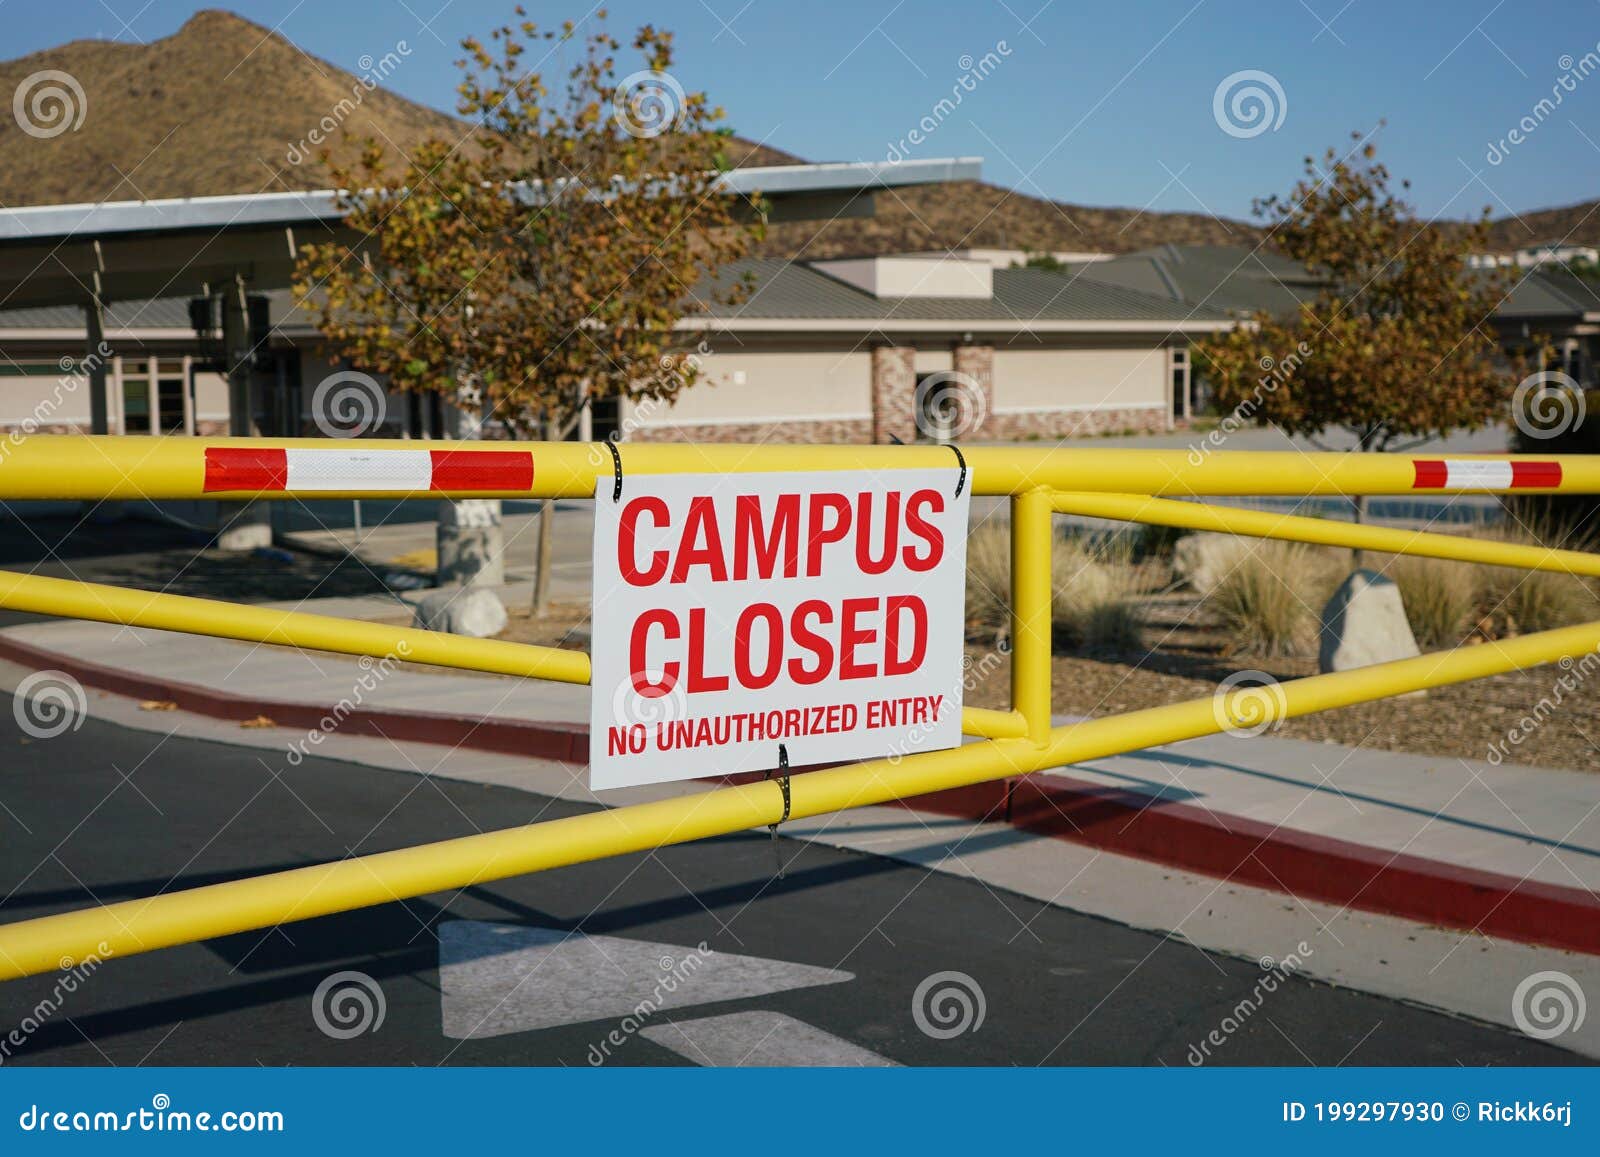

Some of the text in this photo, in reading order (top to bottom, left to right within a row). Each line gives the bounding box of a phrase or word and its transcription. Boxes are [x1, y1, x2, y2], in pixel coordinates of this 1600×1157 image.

[617, 488, 945, 587] CAMPUS
[629, 594, 929, 699] CLOSED
[608, 694, 944, 756] NO UNAUTHORIZED ENTRY
